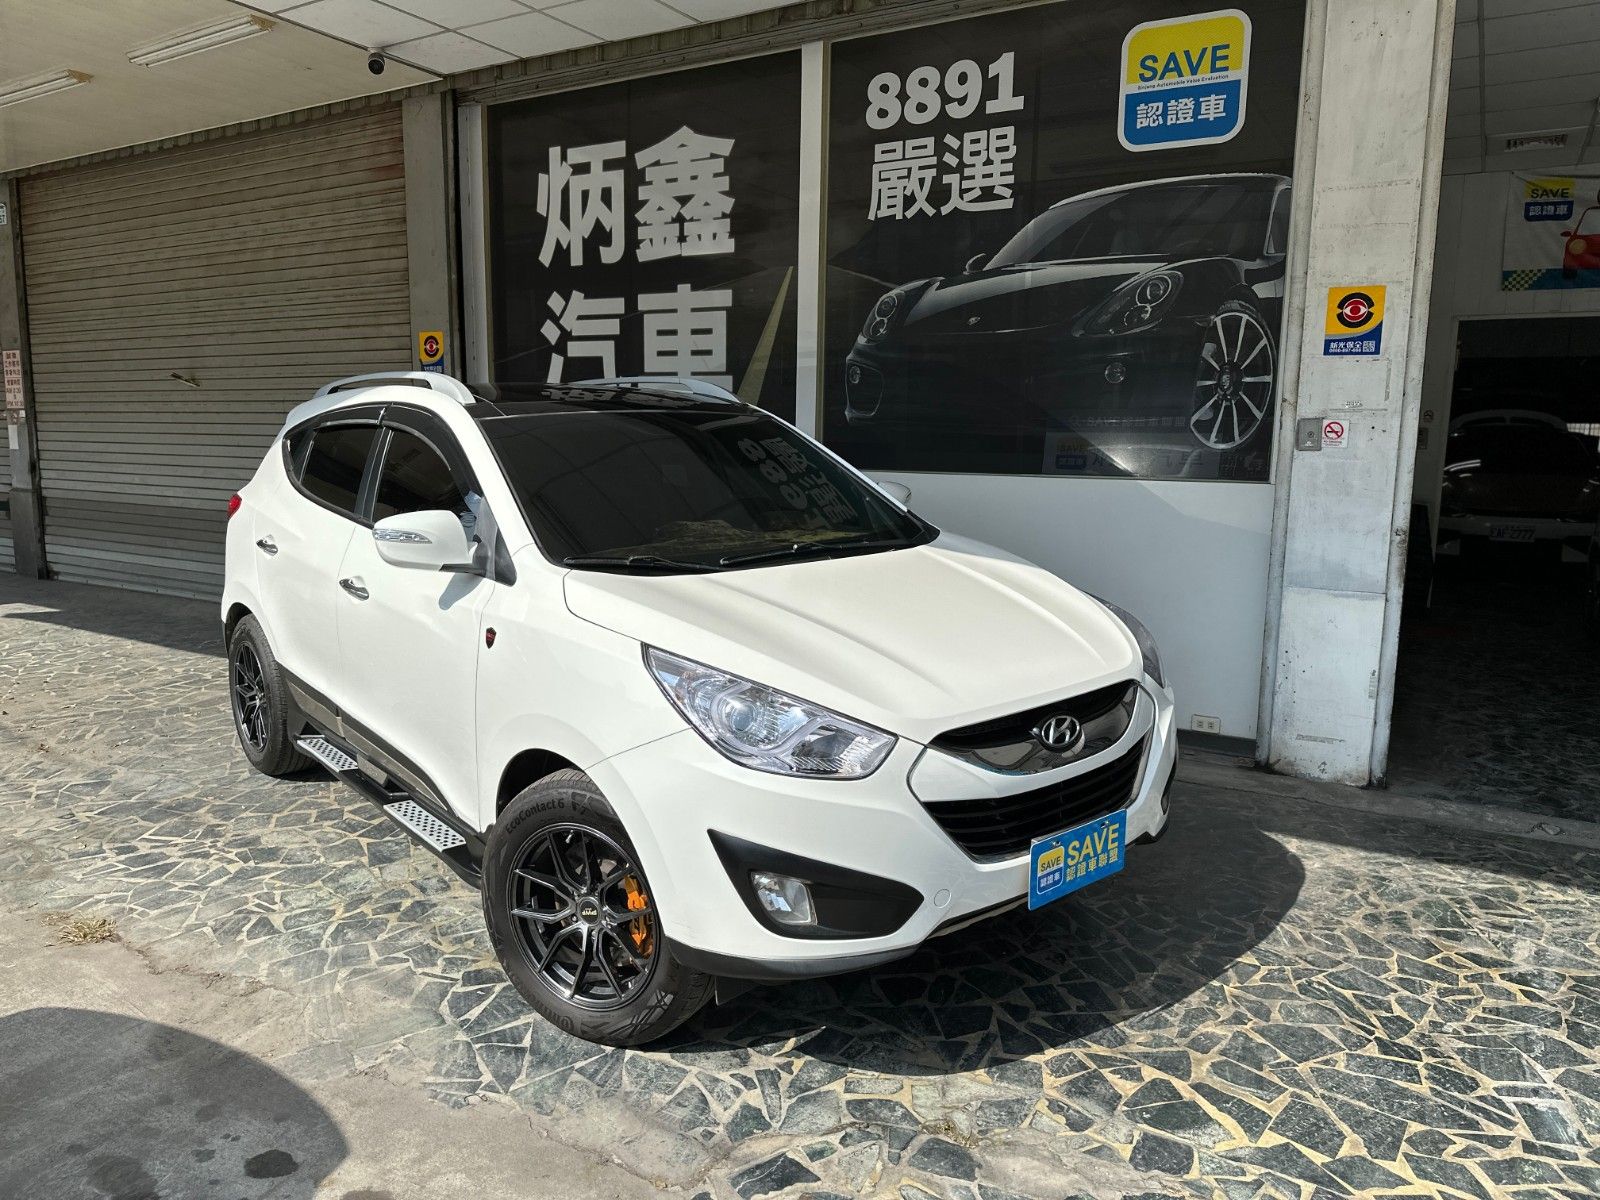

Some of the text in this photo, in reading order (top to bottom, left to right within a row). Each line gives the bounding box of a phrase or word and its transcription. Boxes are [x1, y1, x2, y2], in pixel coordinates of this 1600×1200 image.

[1138, 44, 1230, 82] SAVE
[866, 52, 1025, 130] 8891
[1136, 94, 1227, 129] 認證車
[867, 126, 1017, 221] 嚴選
[1530, 187, 1570, 199] SAVE
[536, 126, 735, 268] 炳鑫
[540, 284, 733, 391] 汽車
[1040, 856, 1062, 873] SAVE
[1067, 823, 1120, 866] SAVE
